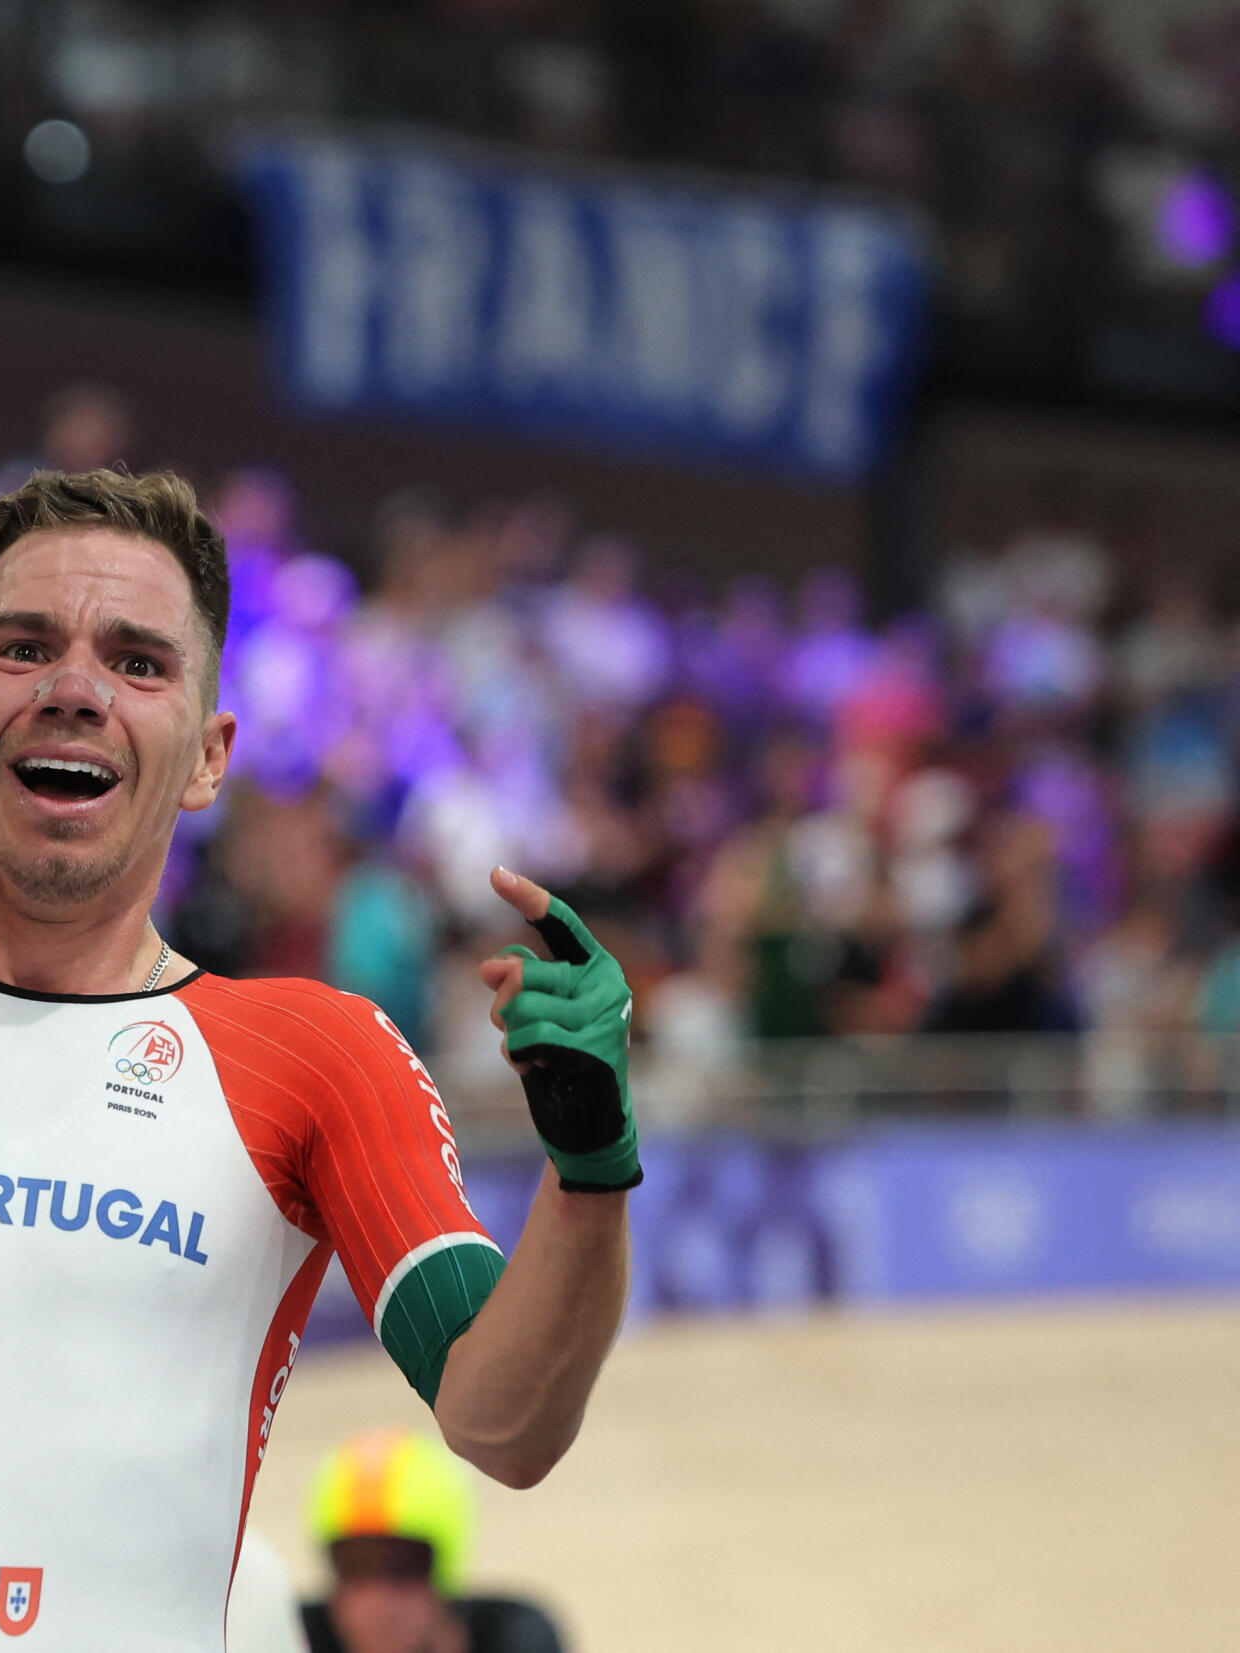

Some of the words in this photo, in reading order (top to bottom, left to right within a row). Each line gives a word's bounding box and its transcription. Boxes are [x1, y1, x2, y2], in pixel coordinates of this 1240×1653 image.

[106, 1082, 164, 1103] PORTUGAL
[107, 1102, 132, 1113] PARIS
[134, 1107, 157, 1120] 2024
